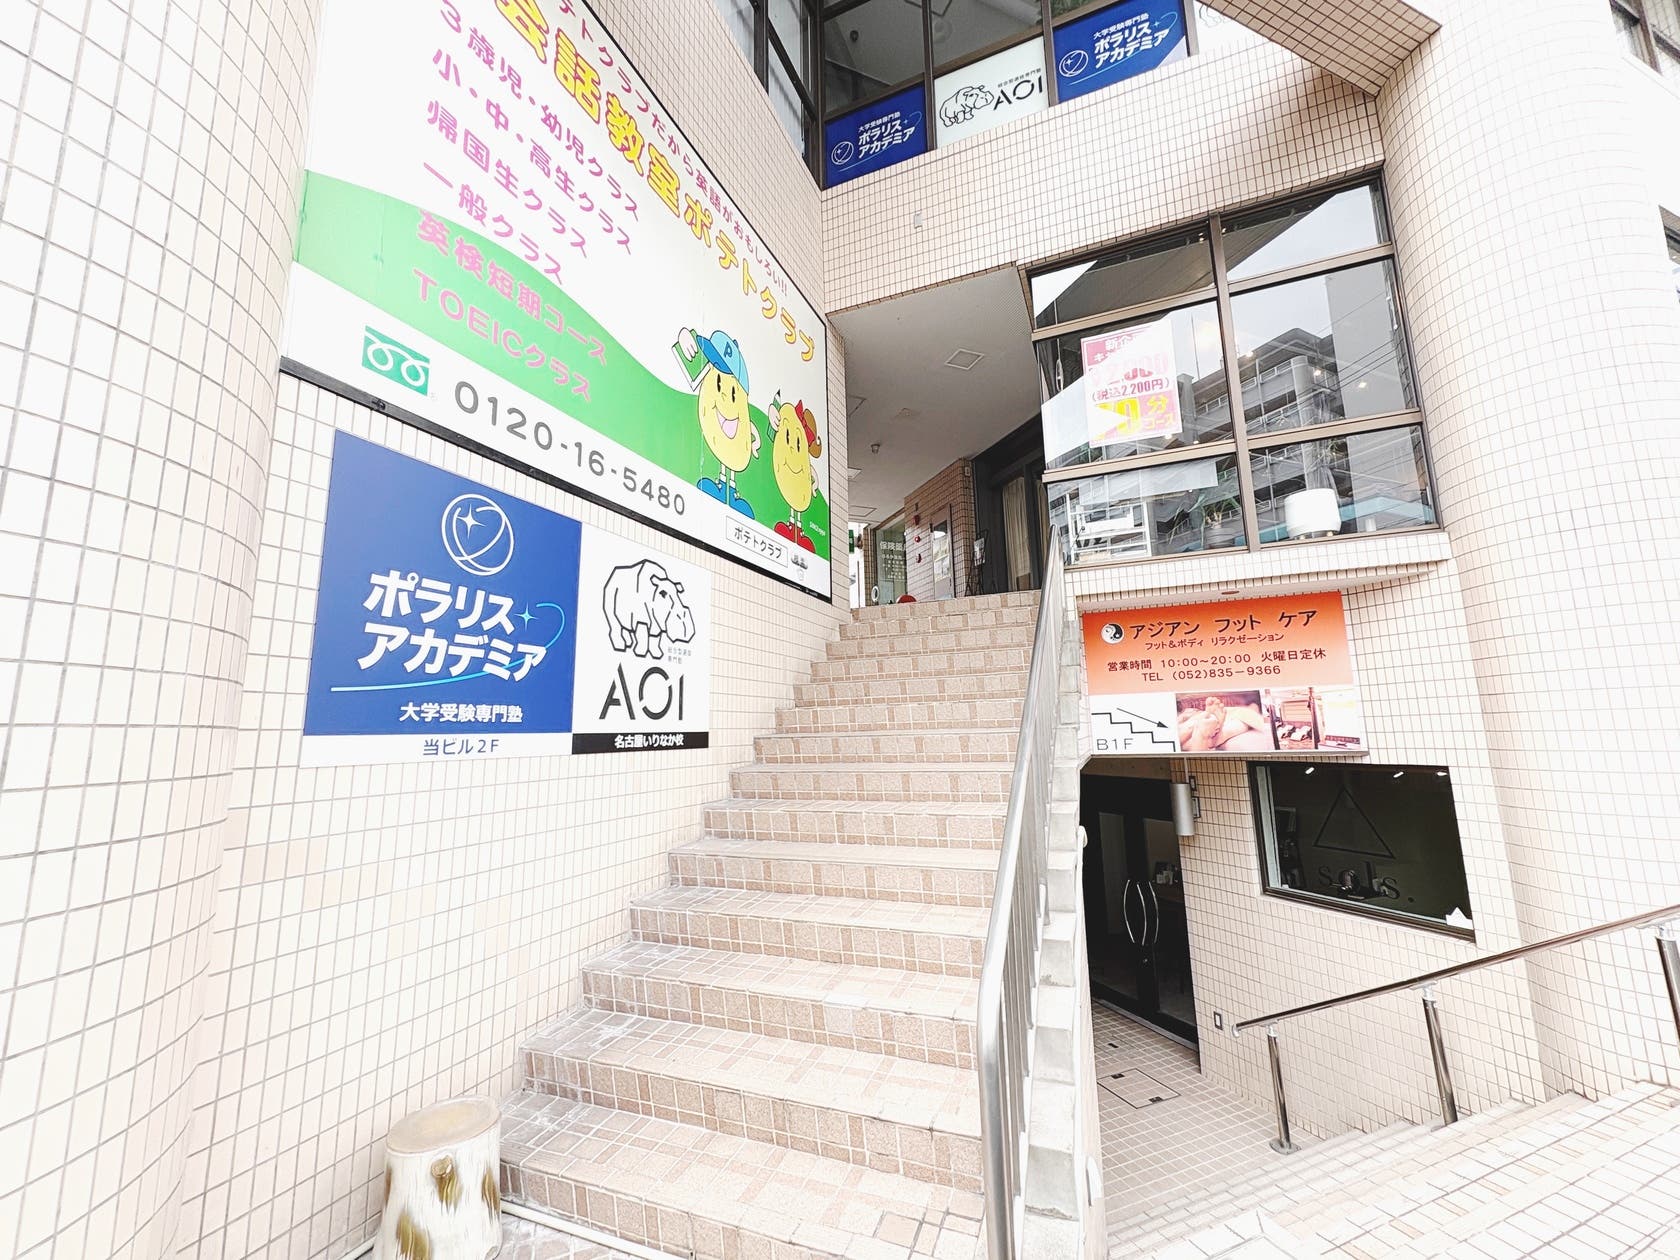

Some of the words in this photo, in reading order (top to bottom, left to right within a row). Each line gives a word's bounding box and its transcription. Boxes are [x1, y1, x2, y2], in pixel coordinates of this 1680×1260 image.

[1094, 21, 1152, 54] ポラリス
[1095, 28, 1170, 69] アカデミア
[993, 75, 1043, 110] AOI
[858, 119, 902, 145] ポラリス
[858, 126, 915, 158] アカデミア
[433, 49, 631, 254] 小・中・高生クラス
[427, 101, 587, 258] 帰国生クラス
[423, 162, 562, 285] 一般クラス
[417, 209, 606, 366] 英検短期コース
[413, 268, 591, 402] TOEICクラス
[1091, 378, 1170, 402] (税込2,200円)
[454, 380, 686, 516] 0120-16-5480
[734, 526, 783, 559] ポテトクラブ
[363, 569, 516, 634] ポラリス
[1130, 620, 1200, 640] アジアン
[1215, 614, 1262, 633] フット
[1278, 609, 1318, 629] ケア
[1210, 632, 1285, 646] リラクゼーション
[357, 621, 547, 682] アカデミア
[1107, 659, 1152, 672] 営業時間
[1261, 648, 1327, 663] 火曜日定休
[599, 662, 684, 721] AOI
[1142, 672, 1163, 682] TEL
[398, 702, 523, 723] 大学受験専門塾
[423, 738, 499, 757] 当ビル2F
[614, 733, 684, 749] 名古屋いりなか校
[1096, 737, 1133, 751] B1F
